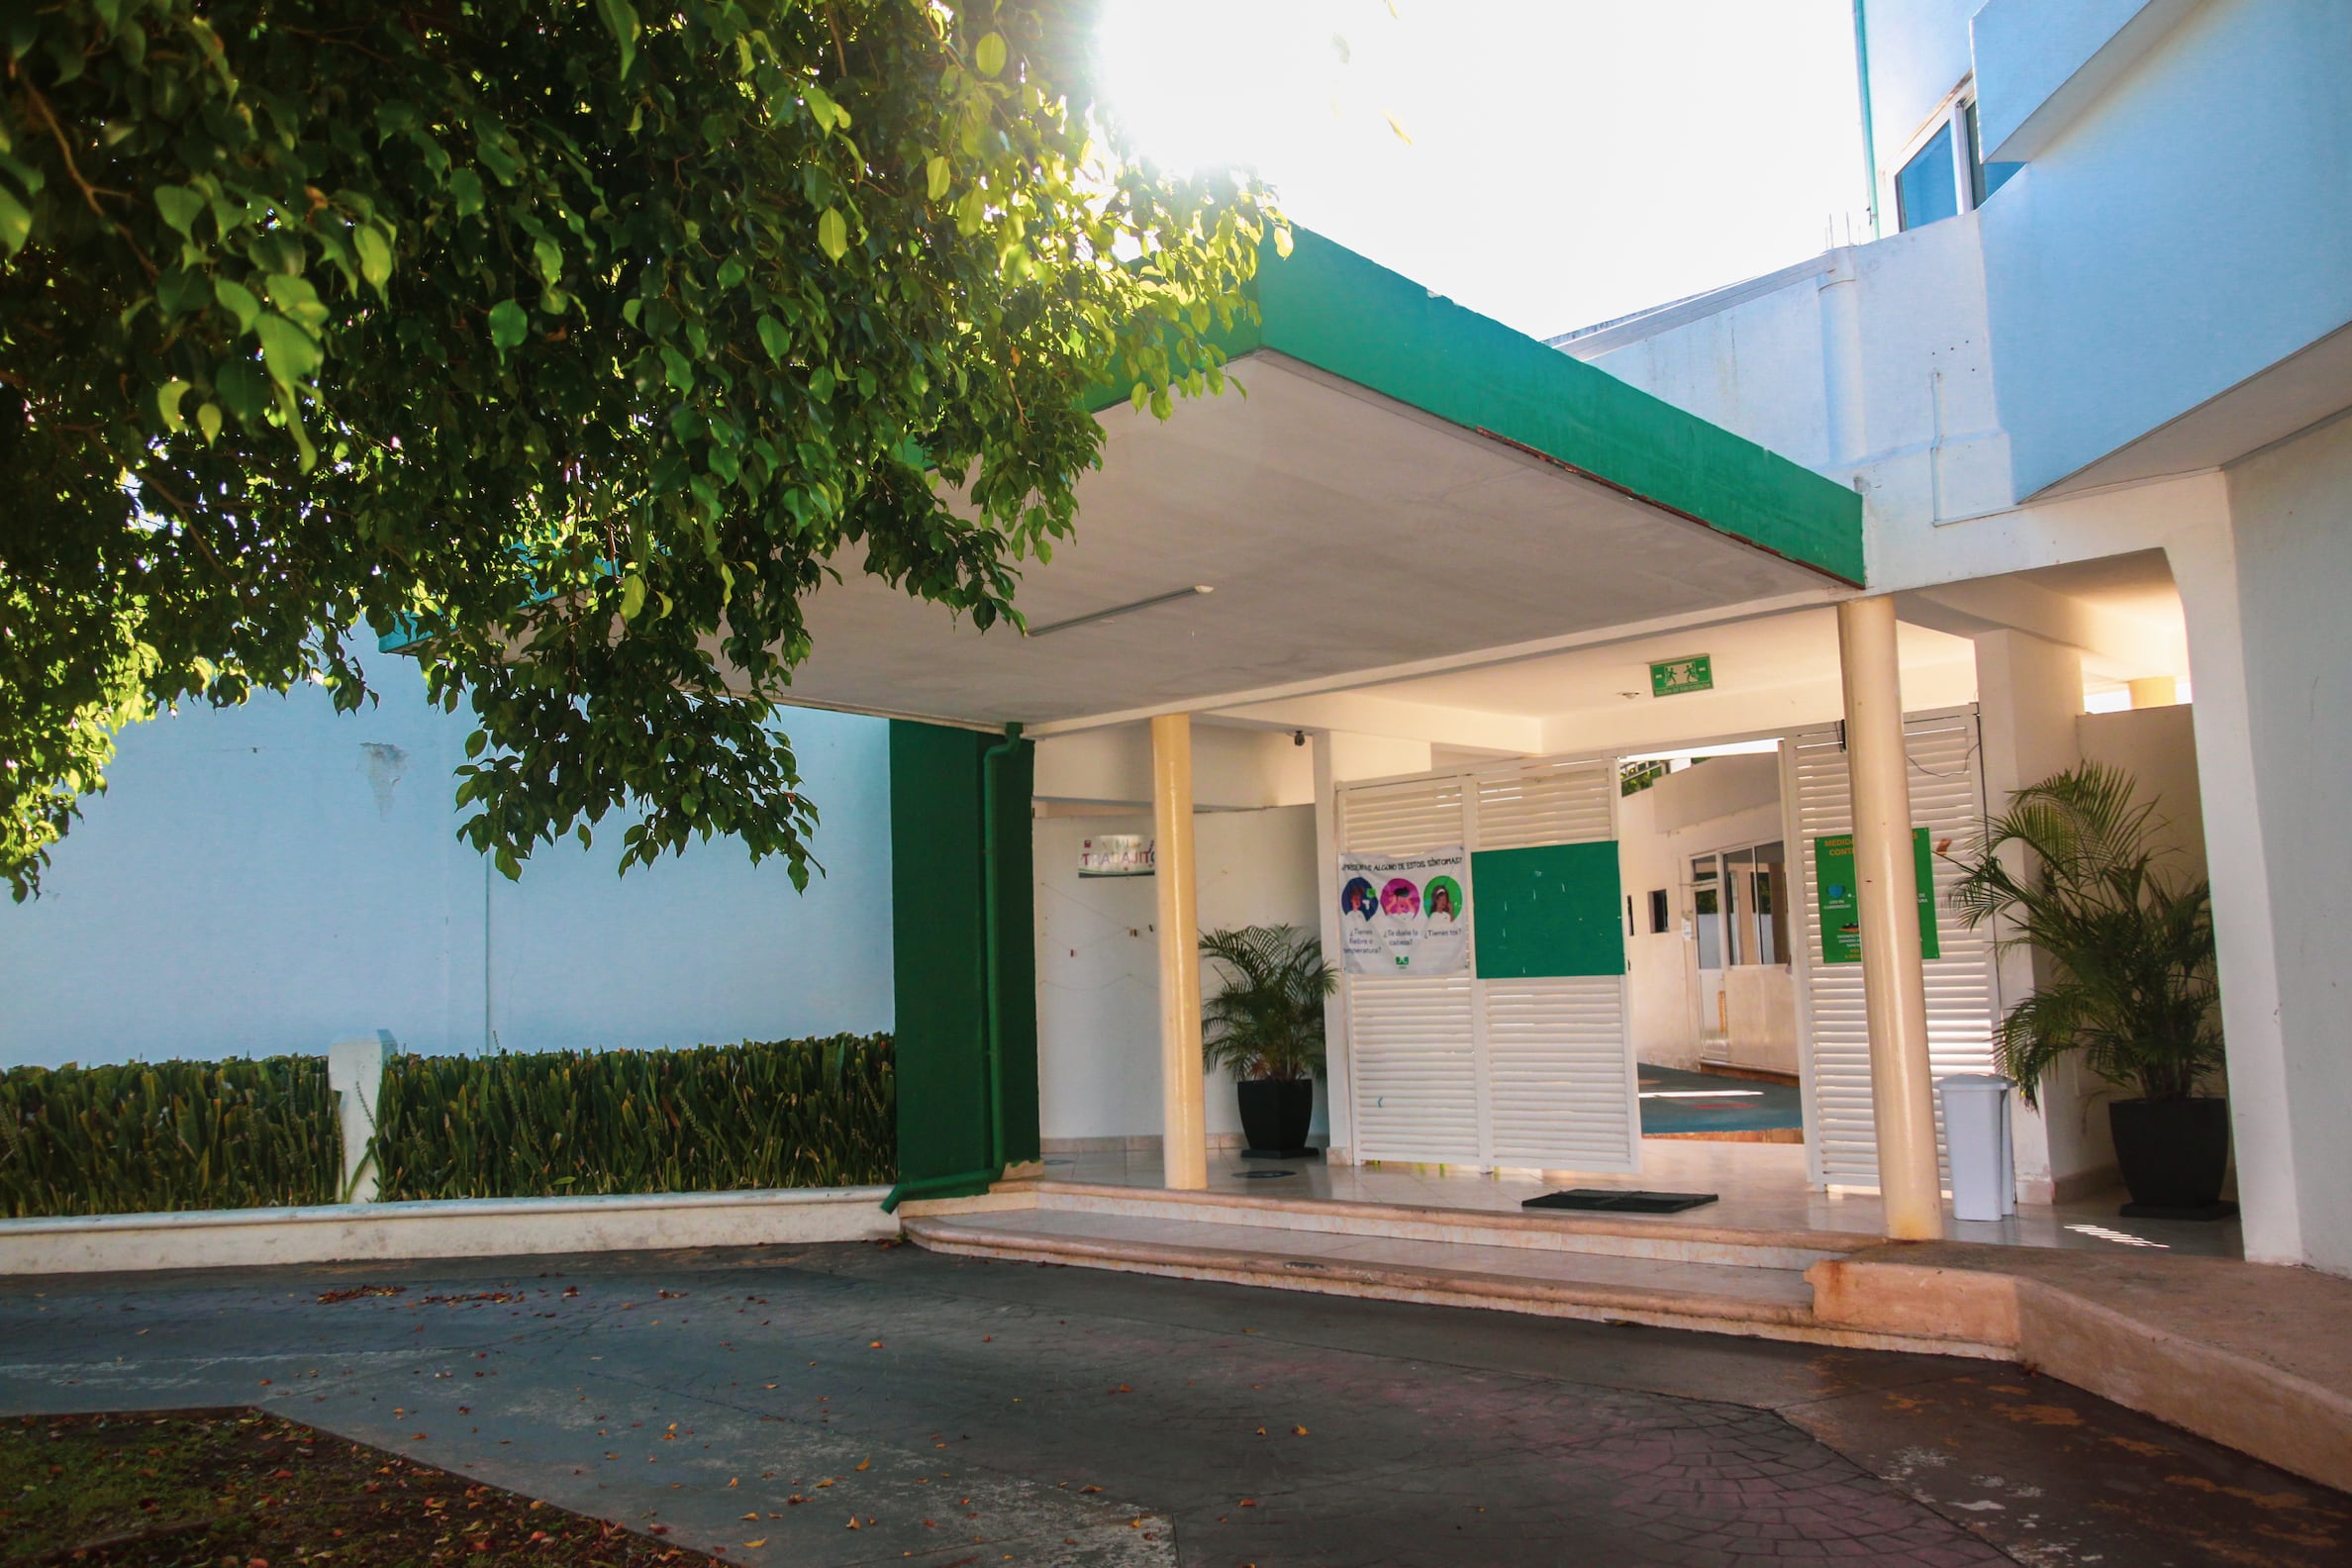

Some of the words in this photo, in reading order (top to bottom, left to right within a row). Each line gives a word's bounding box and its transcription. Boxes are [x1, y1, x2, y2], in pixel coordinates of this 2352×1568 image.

[1824, 838, 1853, 847] MEDID
[1829, 847, 1854, 856] CONT
[1374, 863, 1397, 872] ALGUNO
[1407, 861, 1426, 870] ESTOS
